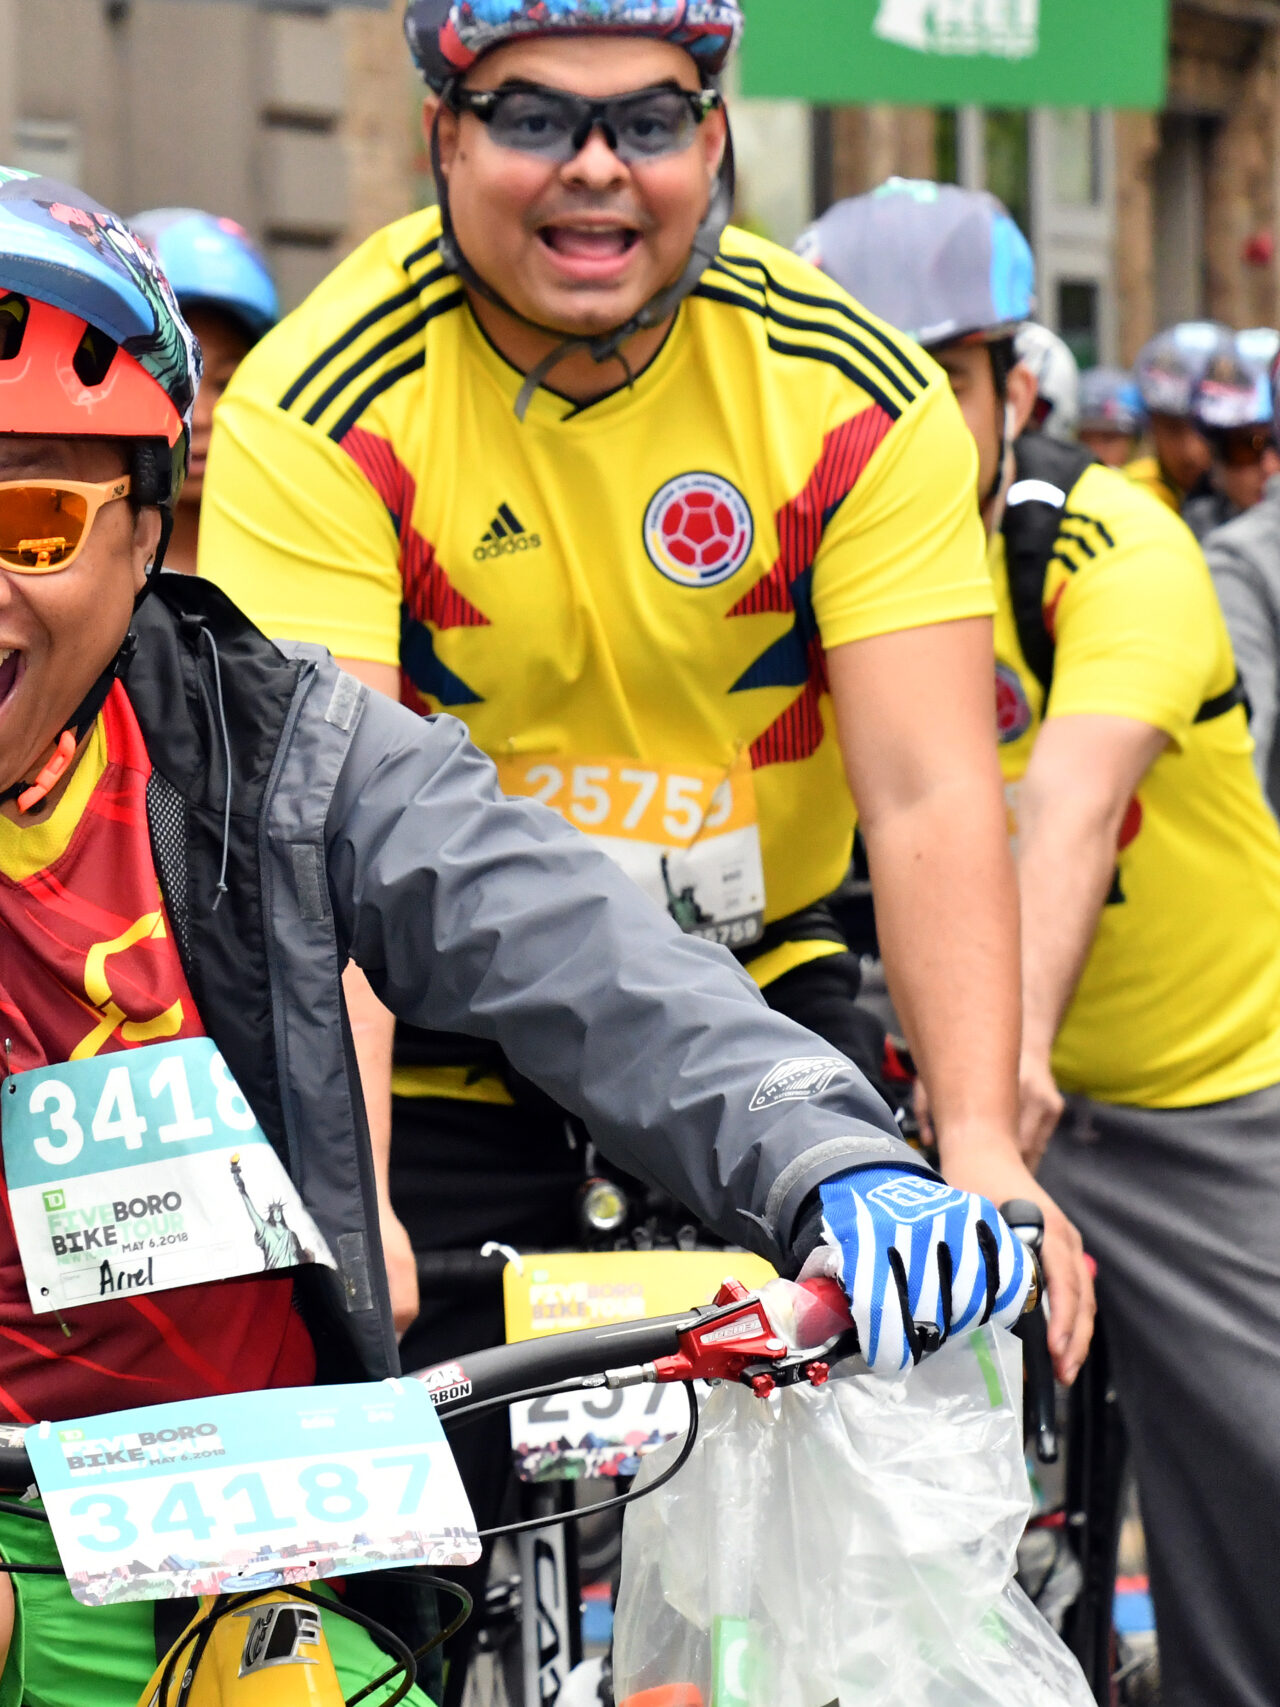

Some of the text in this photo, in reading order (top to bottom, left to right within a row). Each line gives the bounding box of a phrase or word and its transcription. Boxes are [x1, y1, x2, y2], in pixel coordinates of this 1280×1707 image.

[473, 533, 541, 562] adidas
[44, 1192, 64, 1209] TD
[48, 1191, 182, 1236] FIVE BORO
[51, 1225, 118, 1256] BIKE
[119, 1212, 185, 1243] TOUR
[121, 1240, 145, 1254] MAY
[532, 1302, 587, 1320] BIKE
[138, 1422, 218, 1447] BORO
[66, 1448, 145, 1470] BIKE
[149, 1454, 177, 1467] MAY
[69, 1453, 432, 1553] 34187
